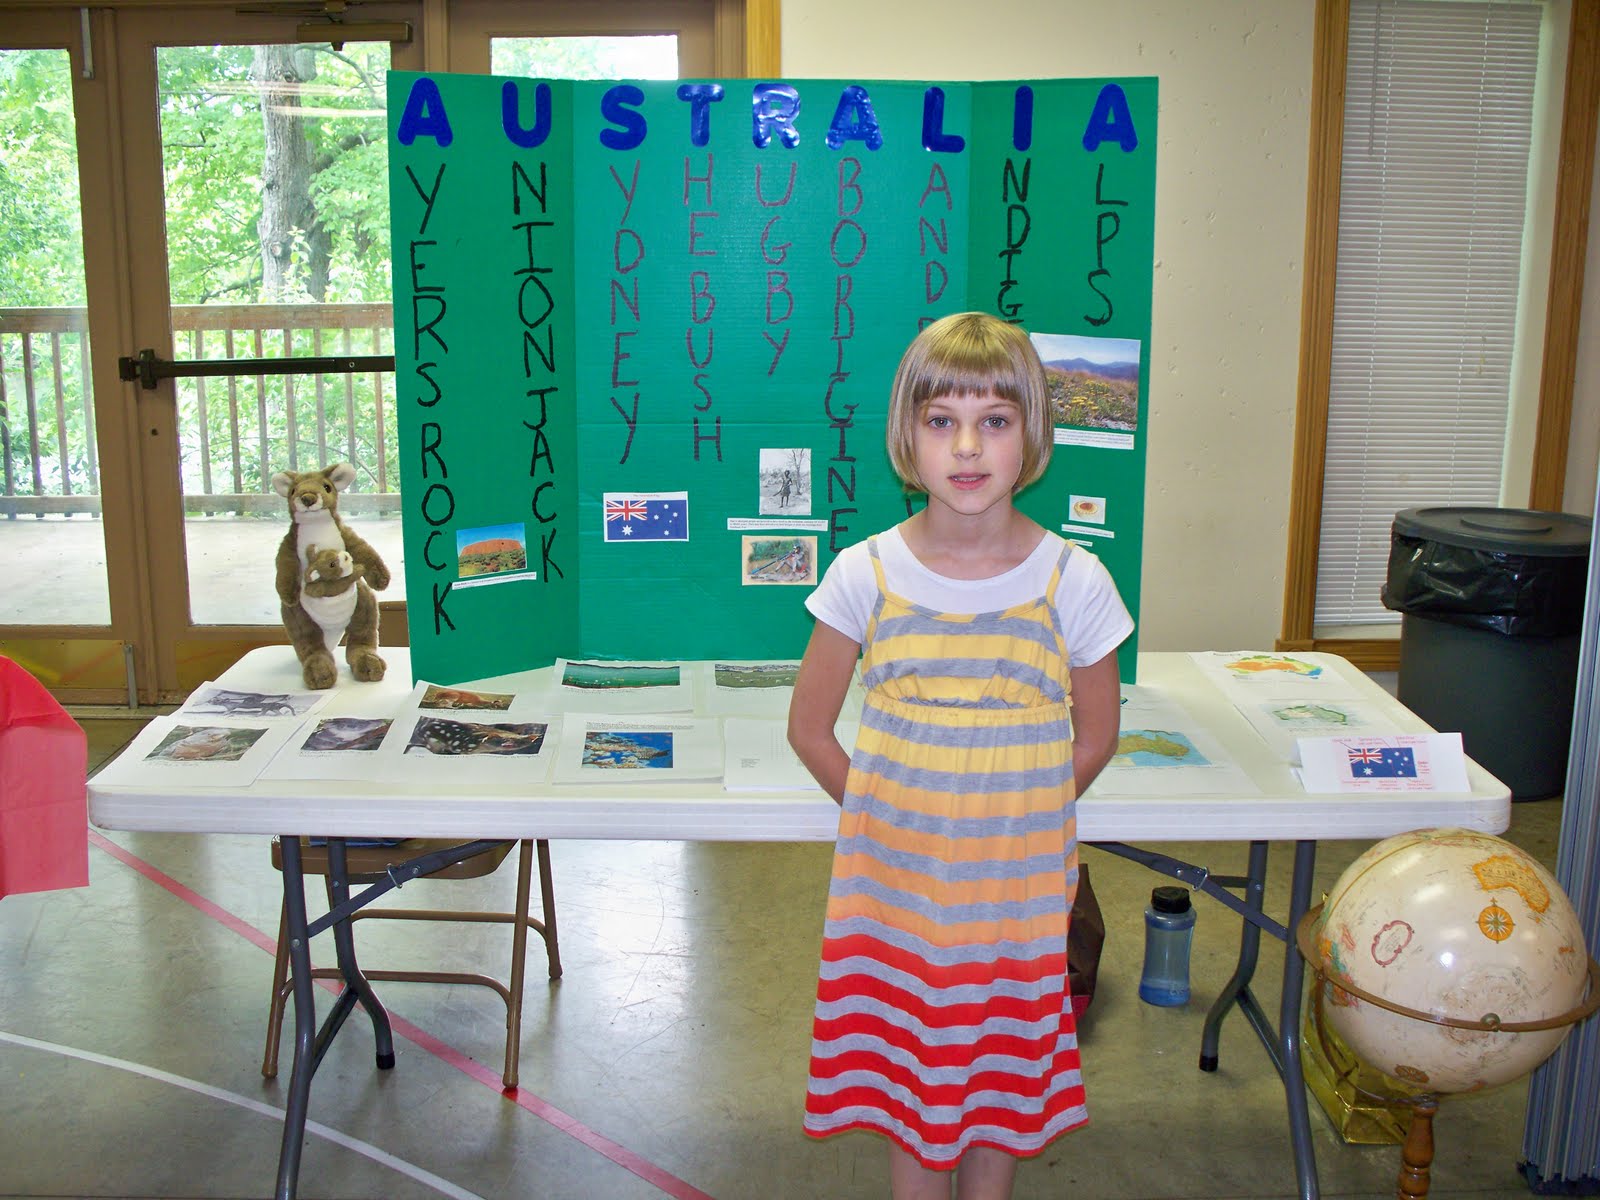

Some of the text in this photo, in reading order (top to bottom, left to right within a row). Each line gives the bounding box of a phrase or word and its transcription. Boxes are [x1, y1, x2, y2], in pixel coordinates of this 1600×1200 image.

[398, 78, 1138, 154] AUSTRALIA
[420, 422, 456, 635] ROCK
[523, 387, 563, 583] JACK
